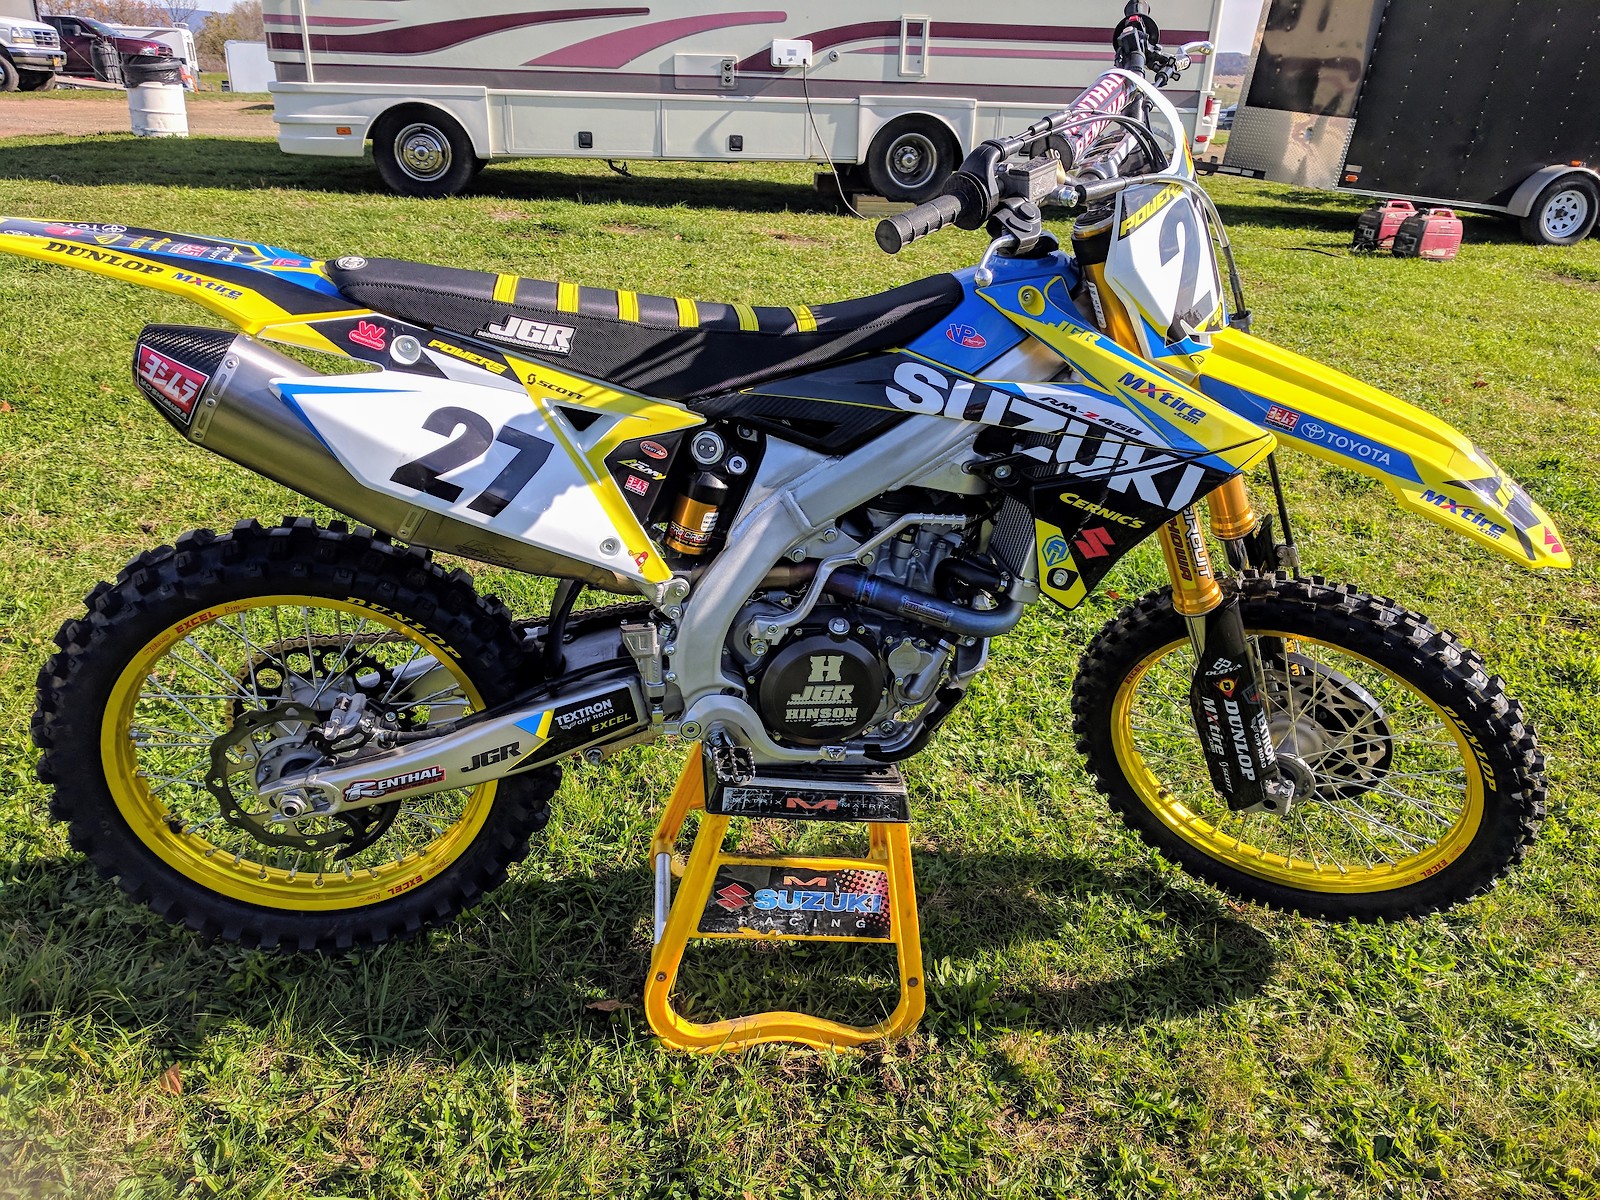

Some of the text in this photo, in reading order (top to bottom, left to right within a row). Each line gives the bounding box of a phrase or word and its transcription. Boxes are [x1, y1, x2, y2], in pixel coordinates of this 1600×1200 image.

[42, 241, 164, 275] DUNLOP
[171, 272, 243, 298] MXtire
[489, 316, 576, 348] JGR
[950, 324, 977, 344] VP
[1047, 321, 1101, 347] JGR
[428, 339, 508, 375] POWERS
[141, 353, 199, 404] ヨシムラ
[537, 379, 586, 400] SCOTT
[1117, 372, 1207, 420] MXtire
[1174, 412, 1199, 425] .com
[886, 362, 1205, 513] SUZUKI
[1327, 431, 1391, 466] TOYOTA
[390, 406, 555, 518] 27
[1059, 492, 1146, 529] CERNIC'S
[1420, 489, 1507, 535] MXtire
[1477, 527, 1501, 540] .com
[175, 611, 218, 634] EXCEL
[343, 596, 461, 659] DUNLOP
[808, 655, 844, 683] H
[1124, 663, 1145, 685] EXCEL
[790, 685, 855, 701] JGR
[555, 699, 613, 726] TEXTRON
[577, 708, 614, 726] OFF ROAD
[591, 713, 632, 733] EXCEL
[785, 707, 858, 720] HINSON
[1202, 696, 1225, 756] MXtire
[1224, 699, 1256, 781] DUNLOP
[1257, 707, 1276, 766] TEXTRON
[1438, 704, 1497, 792] DUNLOP
[460, 741, 522, 773] JGR
[345, 767, 442, 801] RENTHAL
[1222, 768, 1234, 794] SCOTT
[841, 802, 892, 810] MATRIX
[1420, 859, 1448, 877] EXCEL
[387, 875, 424, 895] EXCEL
[753, 888, 882, 913] SUZUKI
[738, 916, 866, 929] RACING
